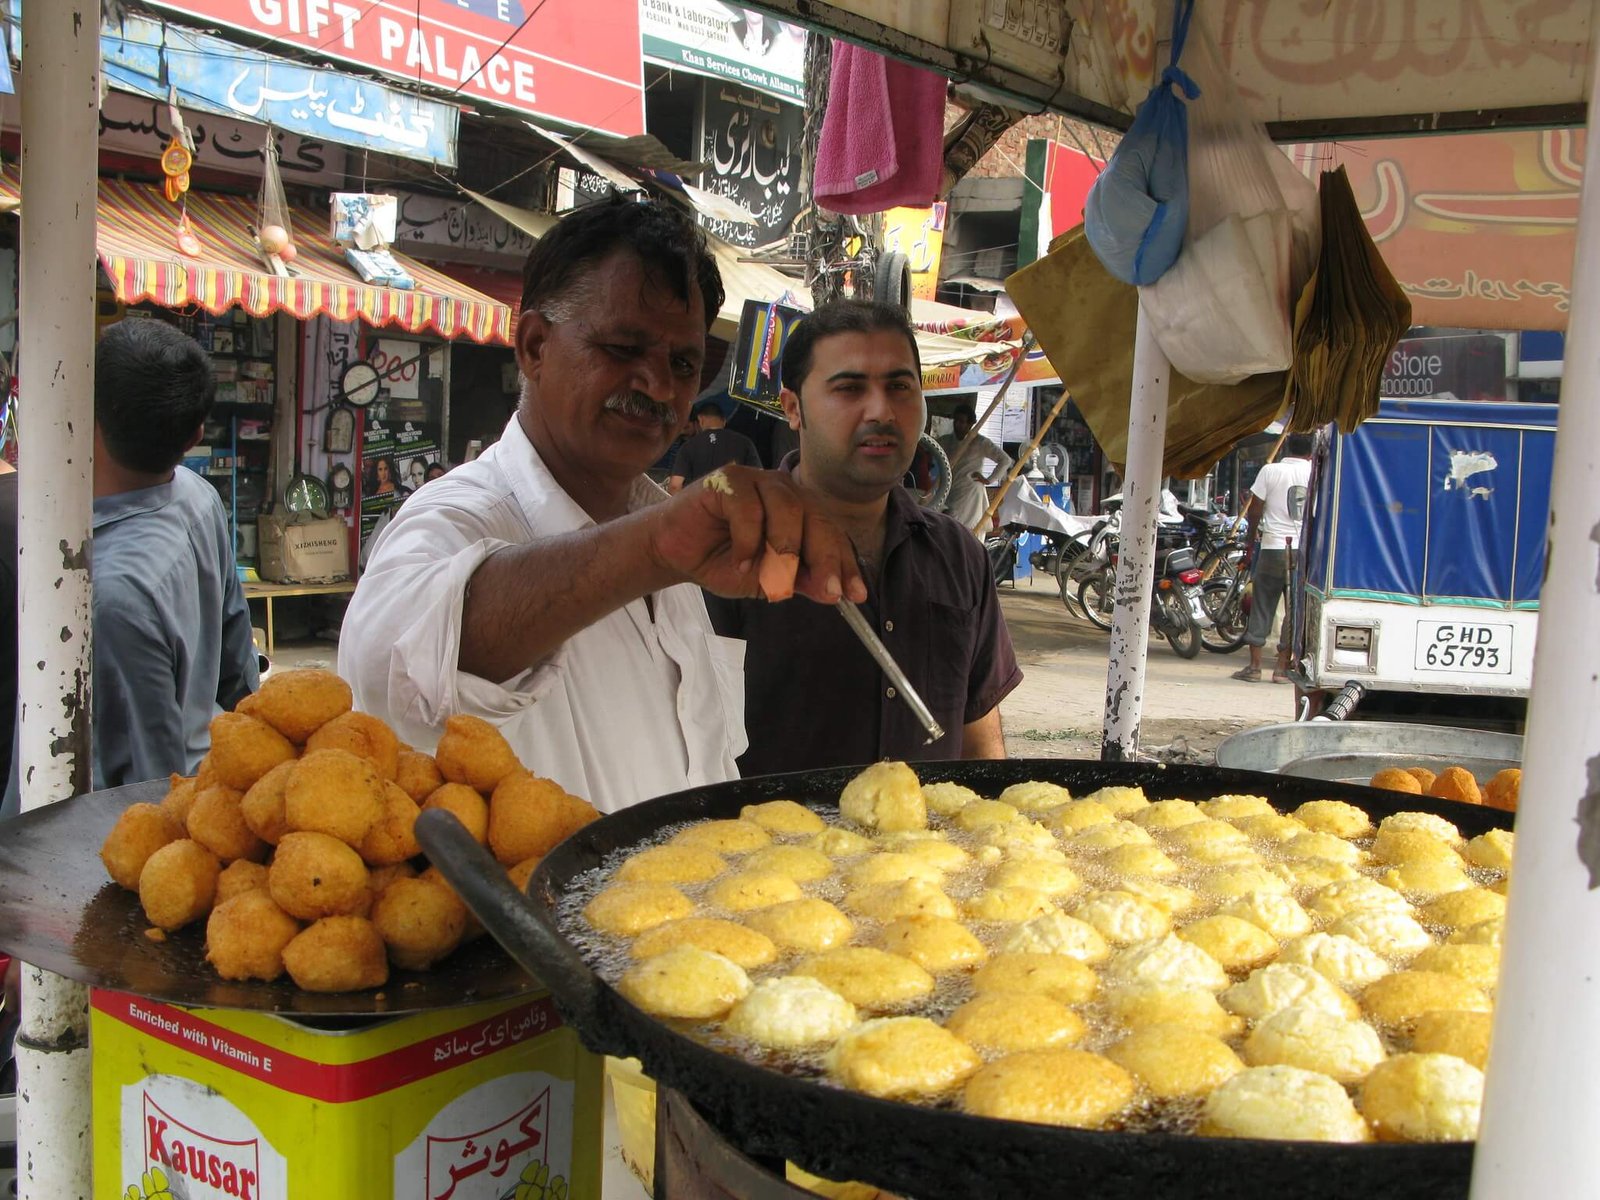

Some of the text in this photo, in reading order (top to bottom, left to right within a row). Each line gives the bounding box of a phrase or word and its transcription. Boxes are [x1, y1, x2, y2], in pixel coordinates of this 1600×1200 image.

[682, 6, 729, 33] Laboratory
[250, 0, 536, 103] GIFT PALACE
[682, 49, 705, 68] Khan
[706, 57, 740, 80] Services
[742, 67, 768, 86] Chowk
[770, 77, 795, 95] Allama
[1392, 351, 1442, 376] Store
[295, 539, 337, 550] XIZHISHENG
[1426, 644, 1499, 668] 65793
[129, 1002, 273, 1073] Enriched with Vitamin E
[147, 1115, 256, 1200] Kausar
[433, 1104, 541, 1200] کوثر
